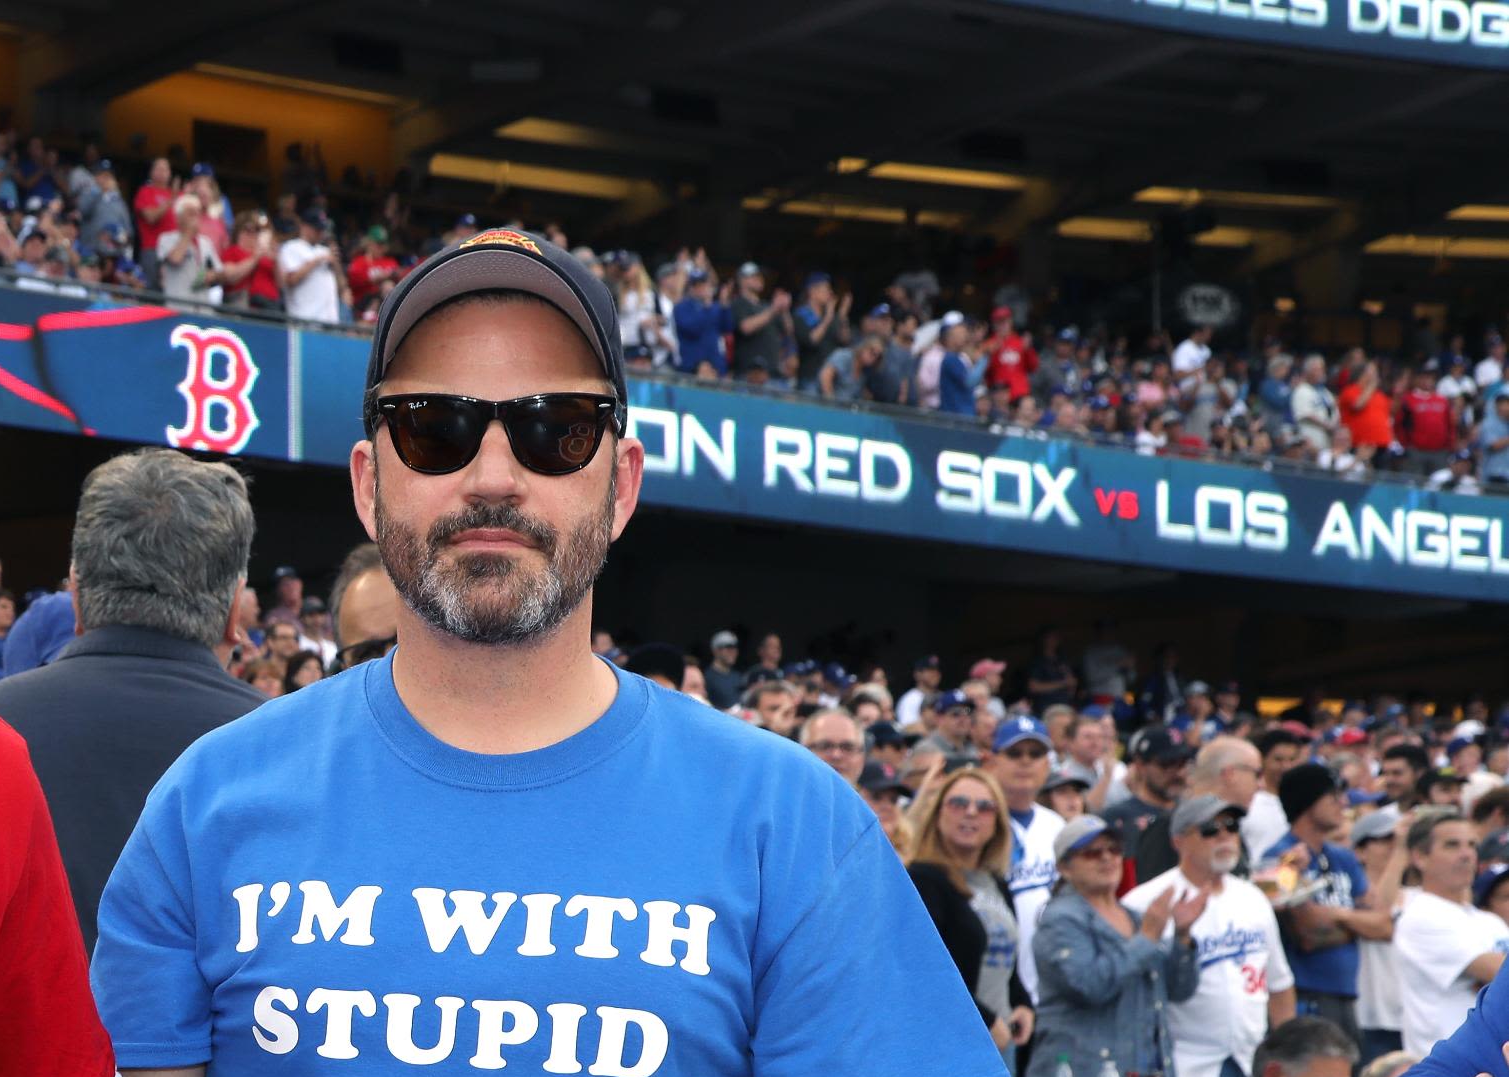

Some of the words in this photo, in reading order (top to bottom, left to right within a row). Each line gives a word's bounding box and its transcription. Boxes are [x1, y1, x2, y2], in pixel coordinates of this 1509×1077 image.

[166, 324, 260, 455] B
[763, 425, 912, 502] RED
[935, 450, 1081, 527] SOX
[1156, 479, 1289, 551] LOS
[232, 880, 383, 953] I'M
[411, 887, 717, 976] WITH
